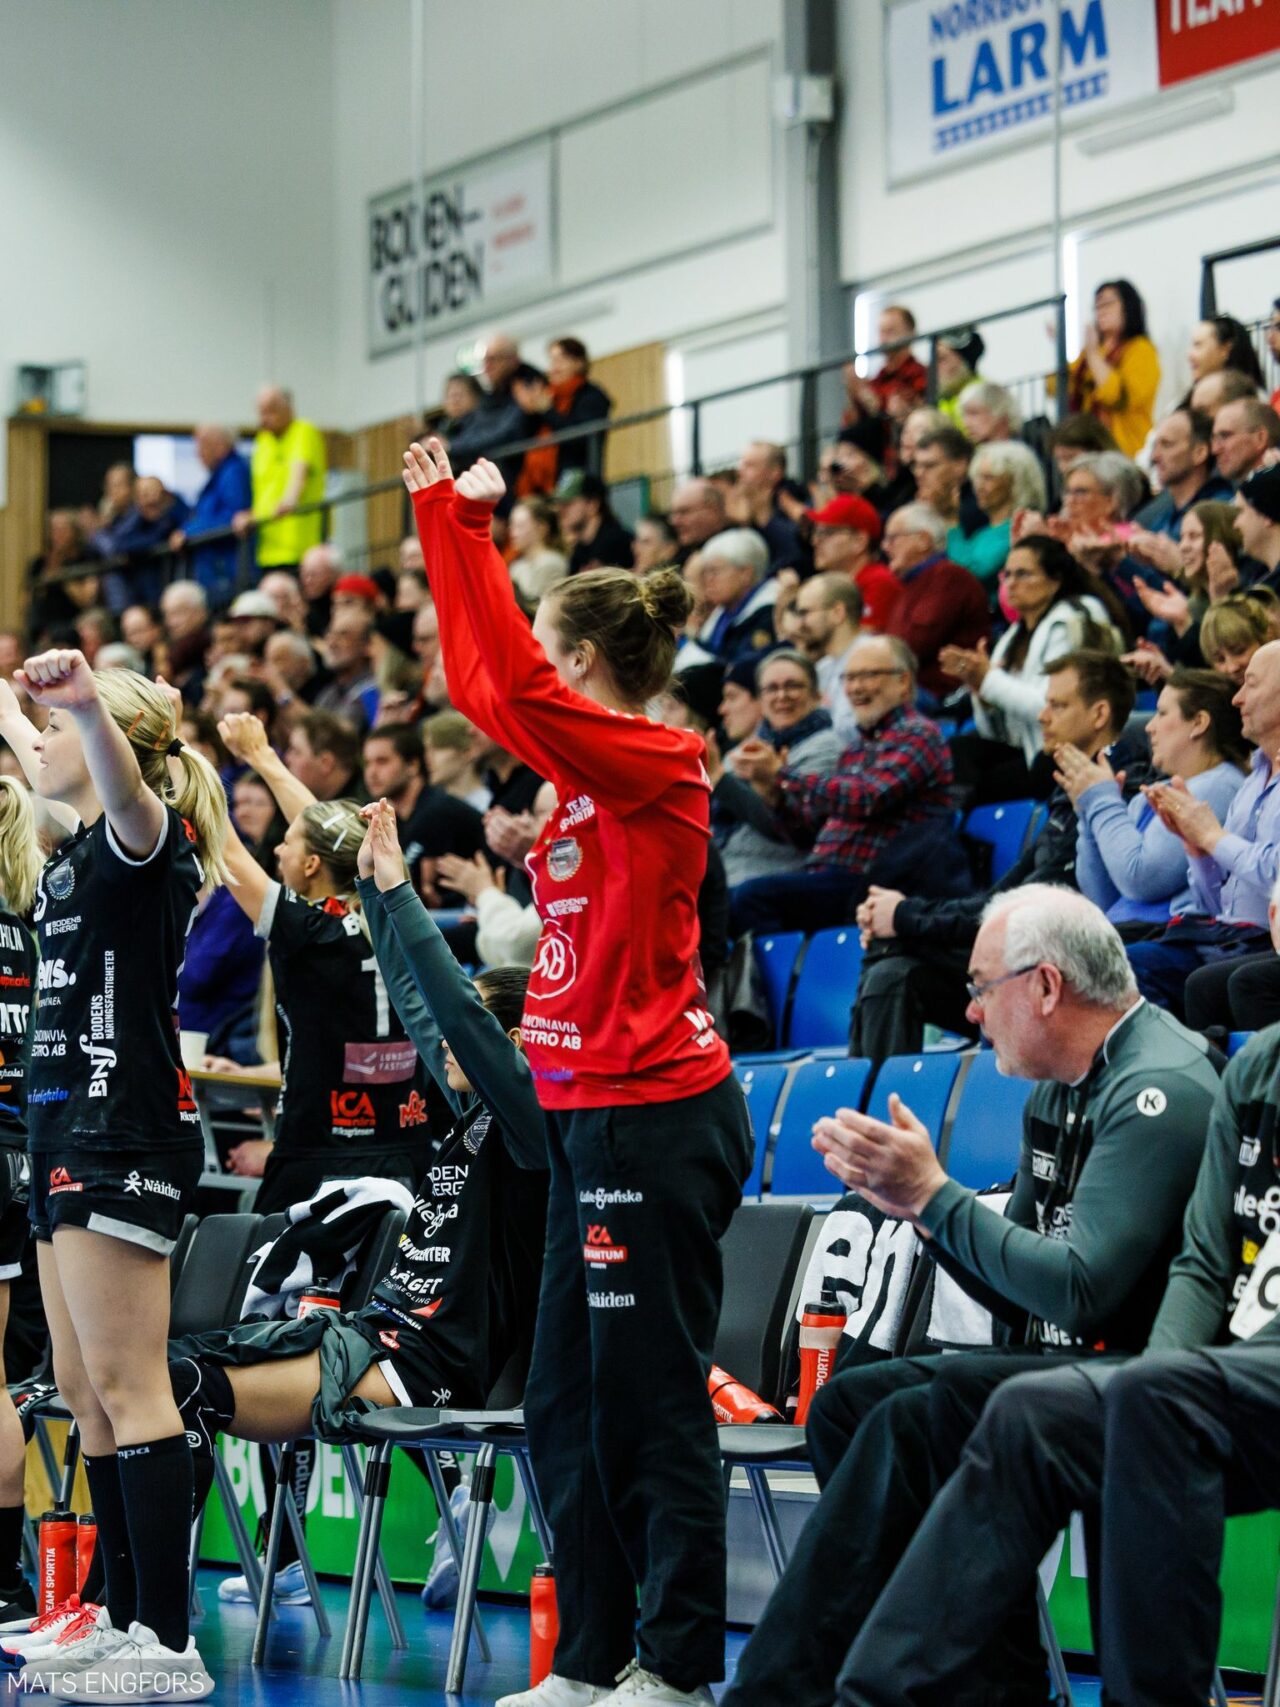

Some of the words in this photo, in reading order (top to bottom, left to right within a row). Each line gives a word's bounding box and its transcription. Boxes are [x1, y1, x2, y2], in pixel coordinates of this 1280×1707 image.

[932, 0, 1108, 117] LARM
[361, 957, 391, 1037] 1
[90, 994, 105, 1041] BODENS
[51, 1043, 67, 1056] AB
[561, 1034, 582, 1050] AB
[330, 1090, 376, 1118] ICA
[586, 1224, 614, 1245] ICA
[45, 1547, 56, 1588] SPORTIA
